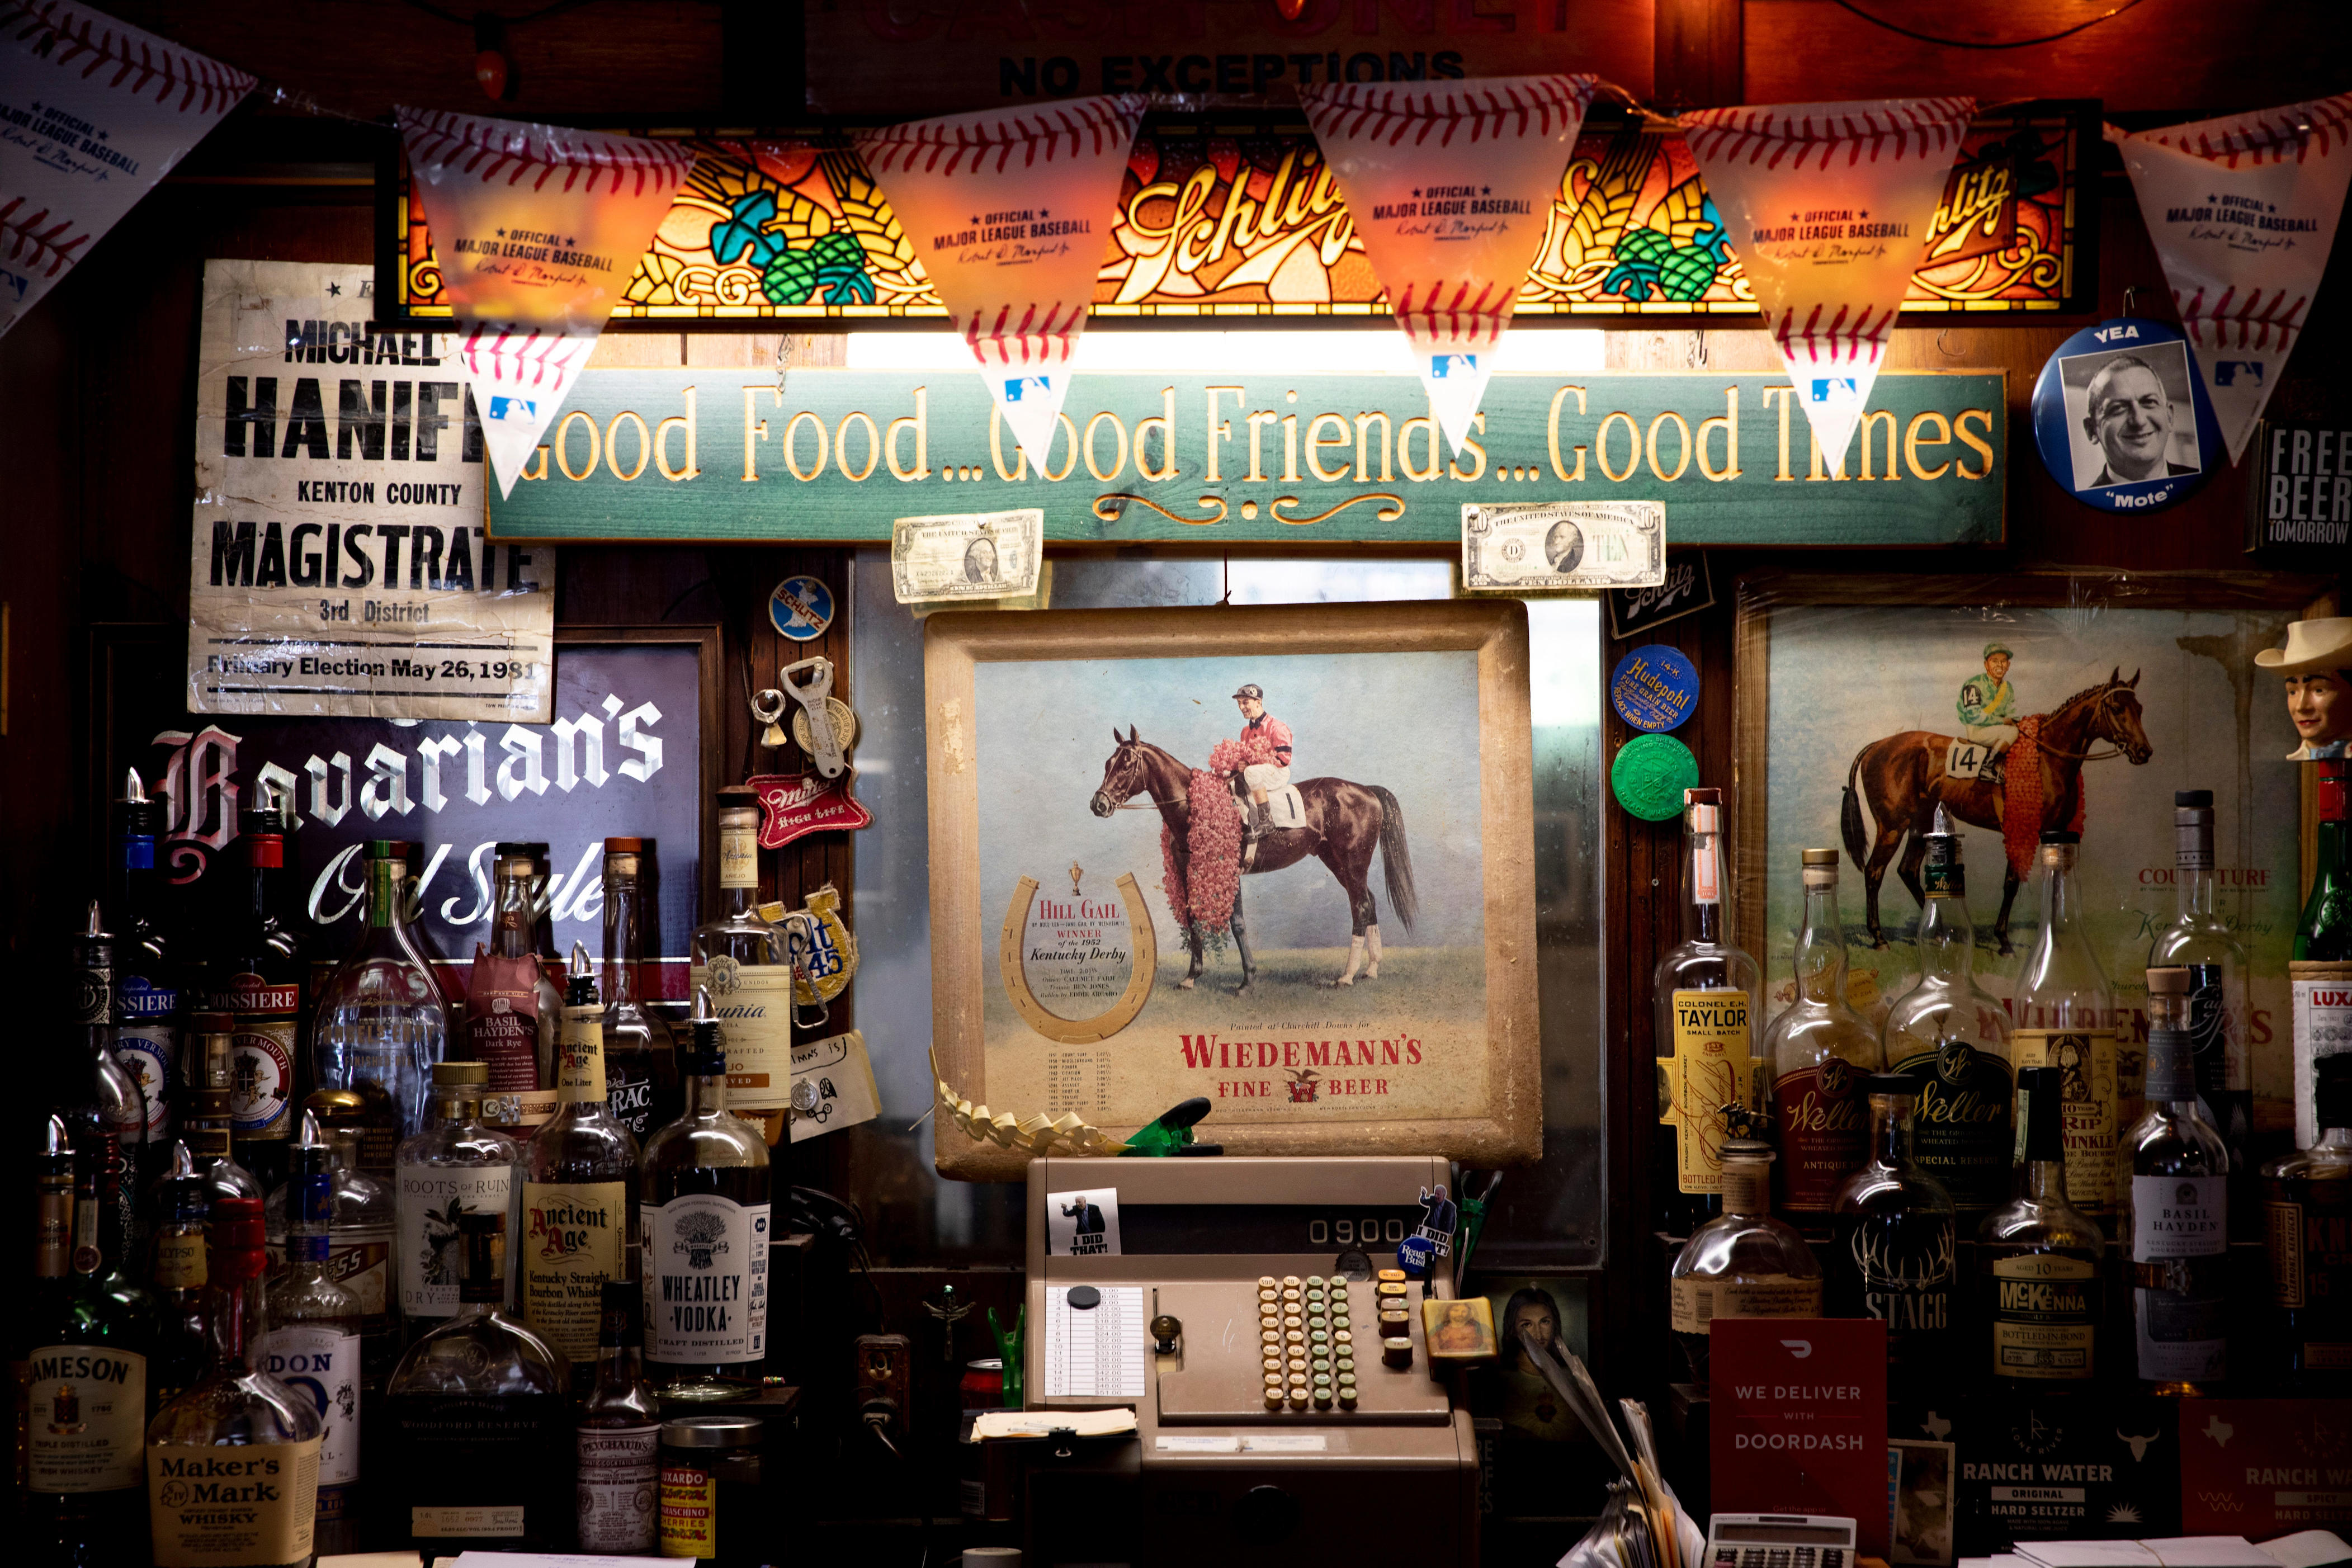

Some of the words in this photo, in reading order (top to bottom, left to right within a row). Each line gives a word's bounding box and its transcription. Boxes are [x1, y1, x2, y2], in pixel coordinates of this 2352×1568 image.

[1000, 56, 1079, 96] NO
[1102, 51, 1464, 94] EXCEPTIONS
[44, 107, 94, 136] OFFICIAL
[0, 103, 32, 127] AJOR
[32, 118, 79, 147] LEAGUE
[79, 139, 139, 176] BASEBALL
[1427, 186, 1476, 199] OFFICIAL
[1373, 202, 1416, 220] MAJOR
[1421, 201, 1467, 216] LEAGUE
[1471, 199, 1532, 215] BASEBALL
[2222, 194, 2264, 213] OFFICIAL
[985, 210, 1035, 224] OFFICIAL
[1805, 210, 1853, 223] OFFICIAL
[2167, 207, 2213, 223] MAJOR
[2216, 208, 2255, 228] LEAGUE
[2259, 215, 2318, 232] BASEBALL
[510, 229, 560, 247] OFFICIAL
[934, 230, 977, 251] MAJOR
[981, 224, 1026, 242] LEAGUE
[1030, 219, 1090, 238] BASEBALL
[1753, 226, 1796, 244] MAJOR
[1799, 225, 1844, 240] LEAGUE
[1848, 223, 1909, 239] BASEBALL
[454, 238, 499, 257] MAJOR
[502, 243, 549, 262] LEAGUE
[553, 249, 613, 272] BASEBALL
[285, 320, 440, 366] MICHAEL
[2094, 325, 2140, 343] YEA
[1547, 385, 1743, 481] Good
[2270, 429, 2352, 474] FREE
[298, 481, 374, 503] KENTON
[387, 483, 461, 505] COUNTY
[2268, 475, 2352, 522] BEER
[1514, 512, 1545, 522] UNITED
[1593, 512, 1634, 525] AMERICA
[2269, 521, 2350, 544] TOMORROW
[210, 521, 539, 593] MAGISTRATE
[320, 599, 349, 621] 3rd
[365, 601, 429, 623] District
[777, 589, 824, 629] SCHLITZ
[207, 657, 293, 677] Primary
[300, 657, 385, 677] Election
[392, 659, 436, 681] May
[1626, 658, 1691, 710] Hudepohl
[1621, 674, 1638, 691] PURE
[1639, 687, 1660, 706] GRAIN
[1660, 703, 1679, 719] BEER
[1963, 687, 1980, 707] 14
[1614, 687, 1626, 713] REPLACE
[1625, 711, 1642, 726] WHEN
[1951, 747, 1977, 771] 14
[767, 778, 836, 811] Miller
[778, 814, 811, 829] HIGH
[815, 805, 845, 820] LIFE
[2217, 869, 2270, 885] TURF
[1057, 930, 1101, 938] WINNER
[808, 949, 843, 977] 45
[1030, 947, 1085, 964] Kentucky
[1090, 947, 1126, 964] Derby
[210, 991, 295, 1009] BOISSIERE
[485, 1017, 520, 1027] BASIL
[1679, 1010, 1746, 1026] TAYLOR
[474, 1026, 533, 1037] HAYDEN'S
[560, 1042, 597, 1059] Ancient
[1179, 1033, 1422, 1068] WIEDEMANN'S
[564, 1054, 589, 1069] Age
[1218, 1081, 1271, 1097] FINE
[1329, 1079, 1388, 1095] BEER
[1914, 1080, 2004, 1123] Weller
[1787, 1091, 1867, 1132] Weller
[2063, 1118, 2101, 1129] RIP
[1803, 1161, 1849, 1170] ANTIQUE
[1915, 1156, 1956, 1165] SPECIAL
[1961, 1156, 2000, 1165] RESERVE
[404, 1179, 457, 1194] ROOTS
[476, 1179, 509, 1193] RUIN
[1683, 1174, 1714, 1184] BOTTLED
[529, 1205, 607, 1238] Ancient
[2164, 1209, 2210, 1218] BASIL
[2153, 1221, 2217, 1231] HAYDEN
[541, 1227, 588, 1256] Age
[1083, 1235, 1103, 1245] DID
[1426, 1231, 1448, 1243] DID
[1070, 1244, 1108, 1255] THAT!
[2037, 1264, 2052, 1274] 10
[530, 1271, 566, 1286] Kentucky
[570, 1271, 610, 1285] Straight
[530, 1285, 563, 1297] Bourbon
[567, 1286, 602, 1297] Whiske
[662, 1275, 740, 1301] WHEATLEY
[406, 1291, 435, 1304] DRY
[675, 1307, 726, 1331] VODKA
[1865, 1292, 1947, 1330] STAGG
[692, 1338, 743, 1347] DISTILLED
[2002, 1330, 2085, 1340] BOTTLED-IN-BOND
[28, 1357, 129, 1387] JAMESON
[1735, 1387, 1766, 1399] WE
[1775, 1386, 1861, 1400] DELIVER
[401, 1420, 472, 1429] WOODFORD
[477, 1420, 539, 1429] RESERVE
[1735, 1434, 1863, 1451] DOORDASH
[2011, 1427, 2032, 1454] LONE
[2038, 1427, 2064, 1455] RIVER
[159, 1457, 279, 1476] Maker's
[1963, 1463, 2033, 1480] RANCH
[2041, 1463, 2115, 1482] WATER
[2246, 1467, 2316, 1485] RANCH
[193, 1483, 279, 1504] Mark
[2011, 1489, 2063, 1499] ORIGINAL
[2307, 1495, 2337, 1503] SPICY
[180, 1513, 258, 1524] WHISKY
[1991, 1505, 2026, 1516] HARD
[2031, 1505, 2085, 1517] SELTZER
[2275, 1510, 2310, 1520] HARD
